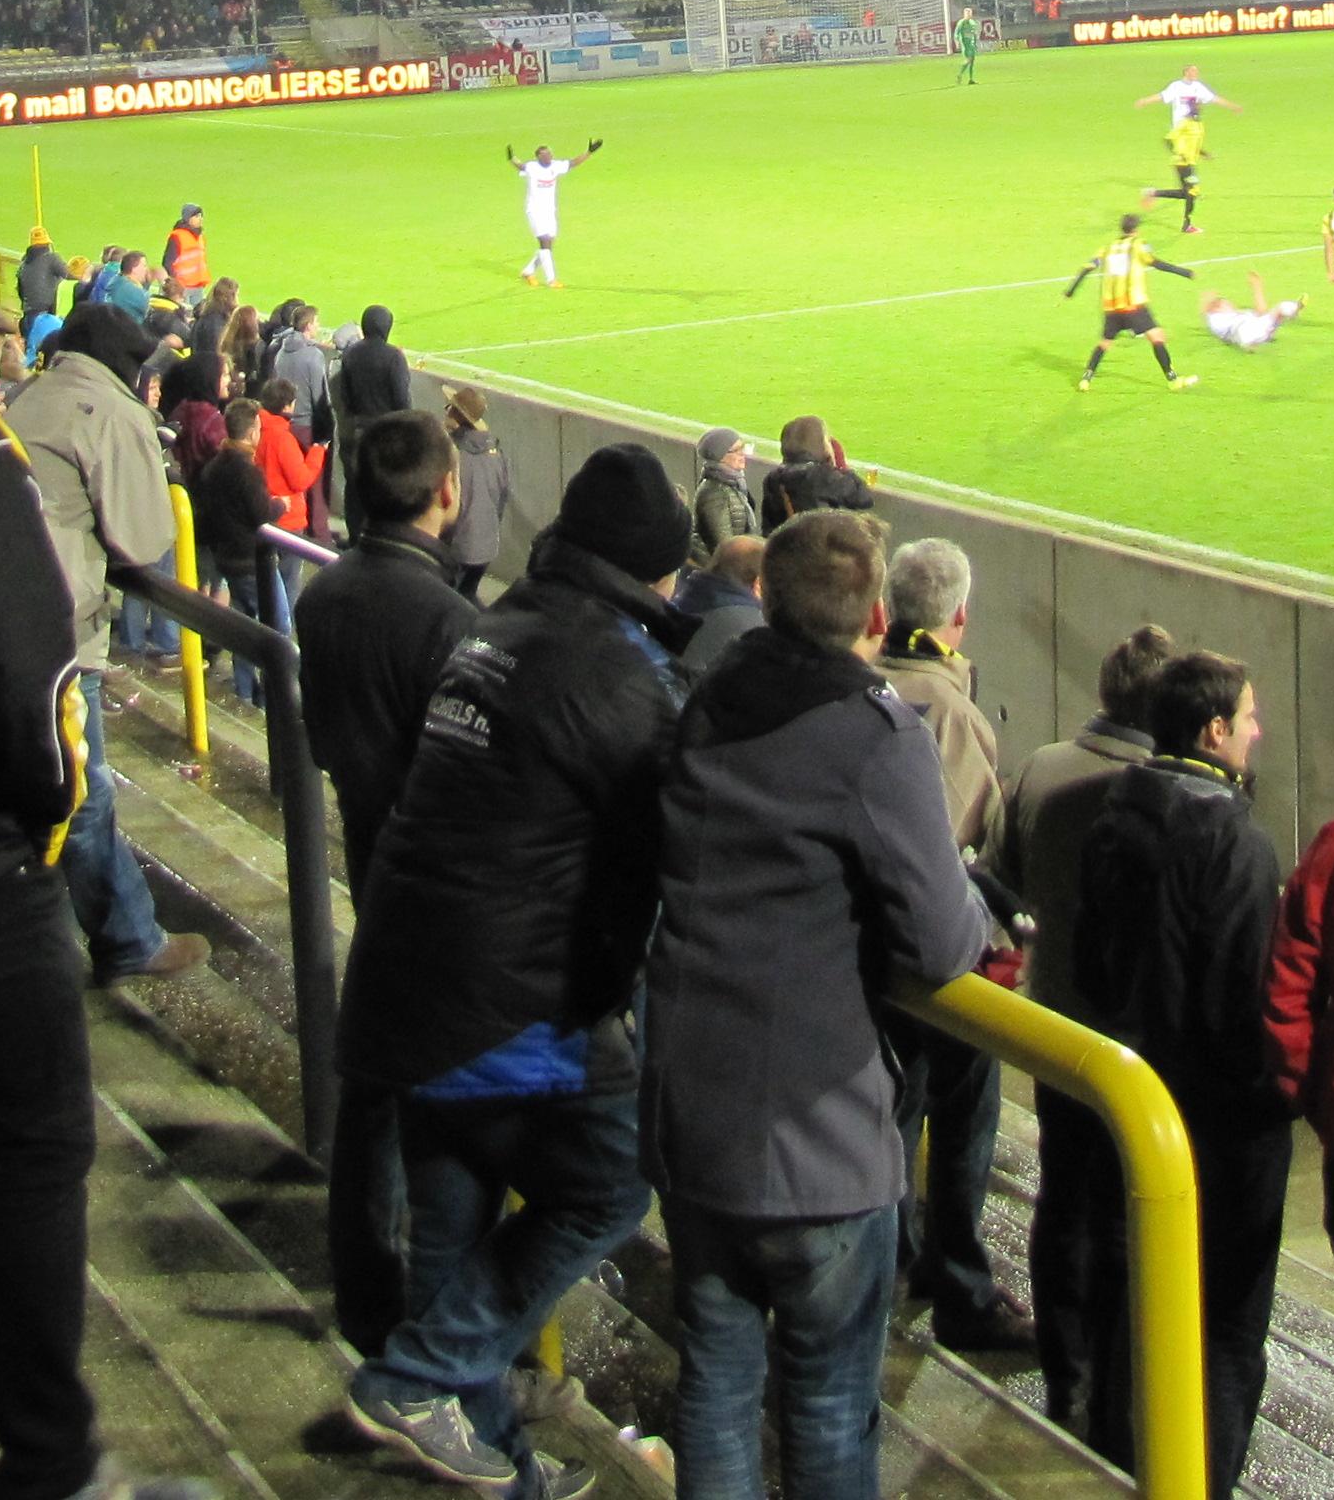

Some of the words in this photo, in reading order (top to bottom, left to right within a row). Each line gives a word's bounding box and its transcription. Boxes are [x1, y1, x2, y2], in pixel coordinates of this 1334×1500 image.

[1073, 21, 1108, 42] uw
[1112, 11, 1233, 39] advertentie
[1236, 6, 1289, 31] hier?
[727, 36, 753, 54] DE
[839, 28, 887, 46] PAUL
[451, 59, 512, 81] Quick
[24, 87, 86, 119] mail
[93, 62, 430, 114] BOARDING@LIERSE.COM
